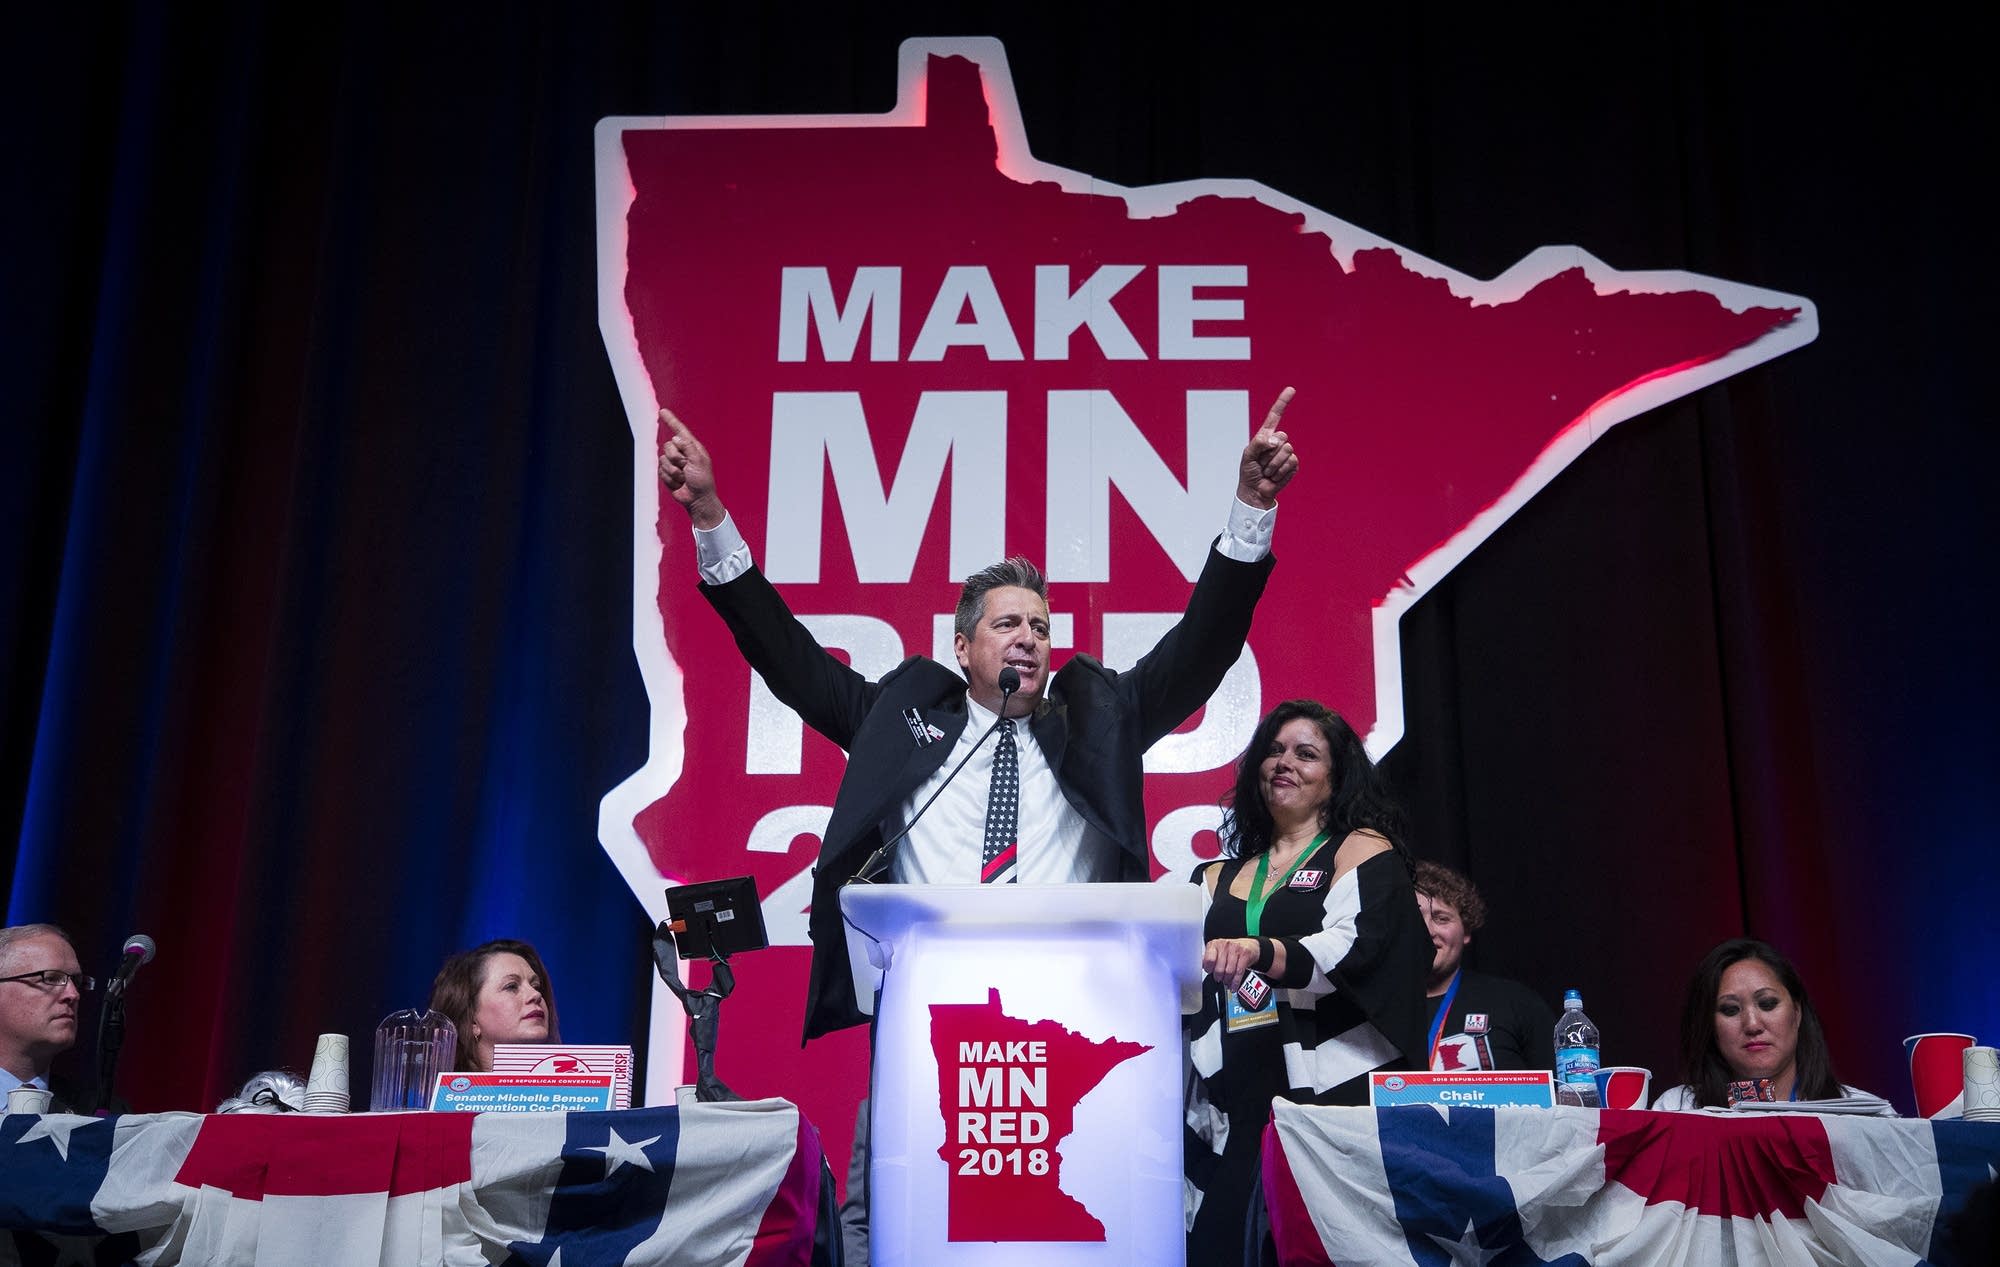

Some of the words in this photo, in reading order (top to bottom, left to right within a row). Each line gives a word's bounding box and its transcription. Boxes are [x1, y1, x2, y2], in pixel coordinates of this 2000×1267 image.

[777, 264, 1252, 363] MAKE
[764, 389, 1250, 584] MN
[745, 611, 1263, 776] RD
[1242, 981, 1261, 999] MN
[958, 1041, 1047, 1063] MAKE
[614, 1053, 628, 1080] CRISP
[445, 1093, 495, 1102] Senator
[497, 1093, 550, 1103] Michelle
[552, 1094, 599, 1104] Benson
[958, 1067, 1047, 1108] MN
[1439, 1090, 1485, 1101] Chair
[455, 1103, 527, 1112] Convention
[958, 1112, 1050, 1144] RED
[958, 1148, 1050, 1176] 2018
